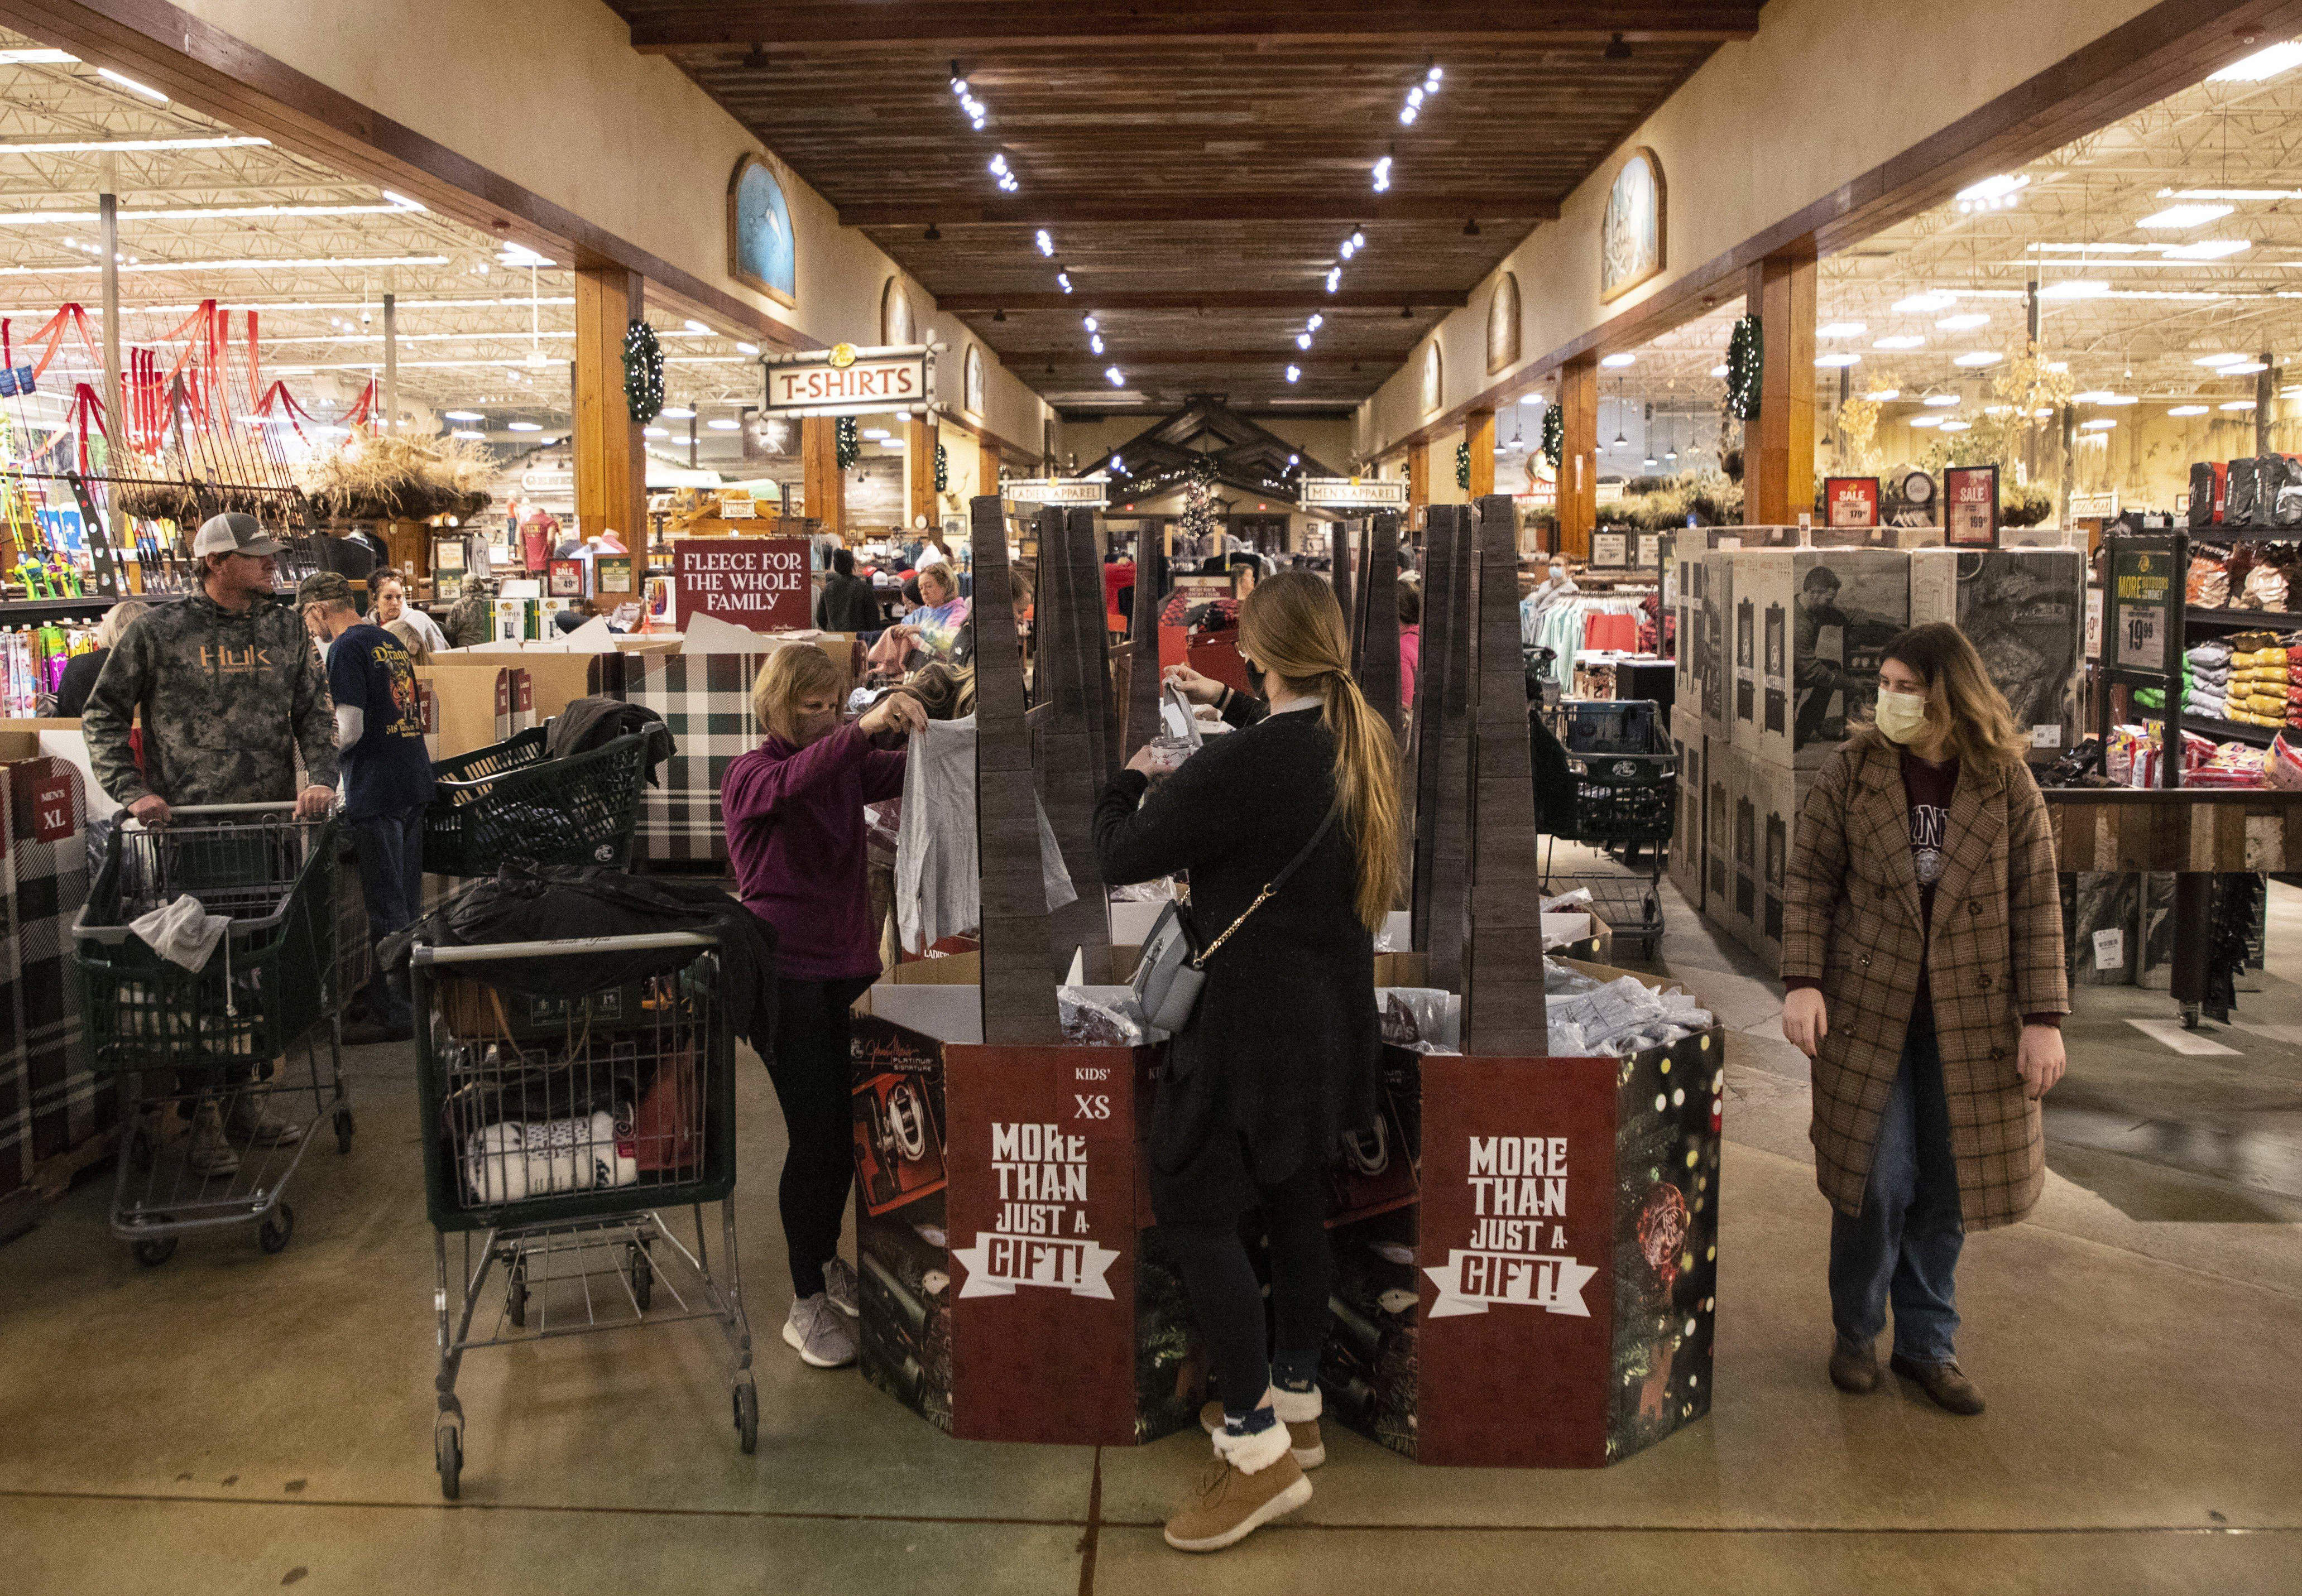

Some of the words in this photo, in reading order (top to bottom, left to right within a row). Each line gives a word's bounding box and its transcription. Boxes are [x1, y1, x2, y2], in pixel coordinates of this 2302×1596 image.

[780, 367, 912, 400] T-SHIRTS
[1054, 487, 1096, 498] APPAREL
[1351, 488, 1395, 499] APPAREL
[1839, 491, 1865, 501] SALE
[1960, 487, 1984, 502] SALE
[555, 568, 574, 576] SALE
[684, 553, 756, 570] FLEECE
[762, 552, 802, 570] FOR
[683, 573, 723, 590] THE
[729, 573, 802, 590] WHOLE
[2118, 575, 2141, 599] MORE
[707, 593, 780, 610] FAMILY
[200, 645, 272, 667] Huk
[44, 809, 66, 830] XL
[1075, 1068, 1111, 1080] KIDS'
[1074, 1094, 1111, 1119] XS
[991, 1122, 1087, 1162] MORE
[1469, 1136, 1567, 1176] MORE
[992, 1162, 1087, 1201] THAN
[1467, 1177, 1567, 1217] THAN
[996, 1203, 1066, 1236] JUST
[1074, 1210, 1090, 1233] A
[1470, 1218, 1544, 1252] JUST
[1551, 1225, 1569, 1249] A
[987, 1237, 1085, 1284] GIFT!
[1460, 1255, 1562, 1301] GIFT!
